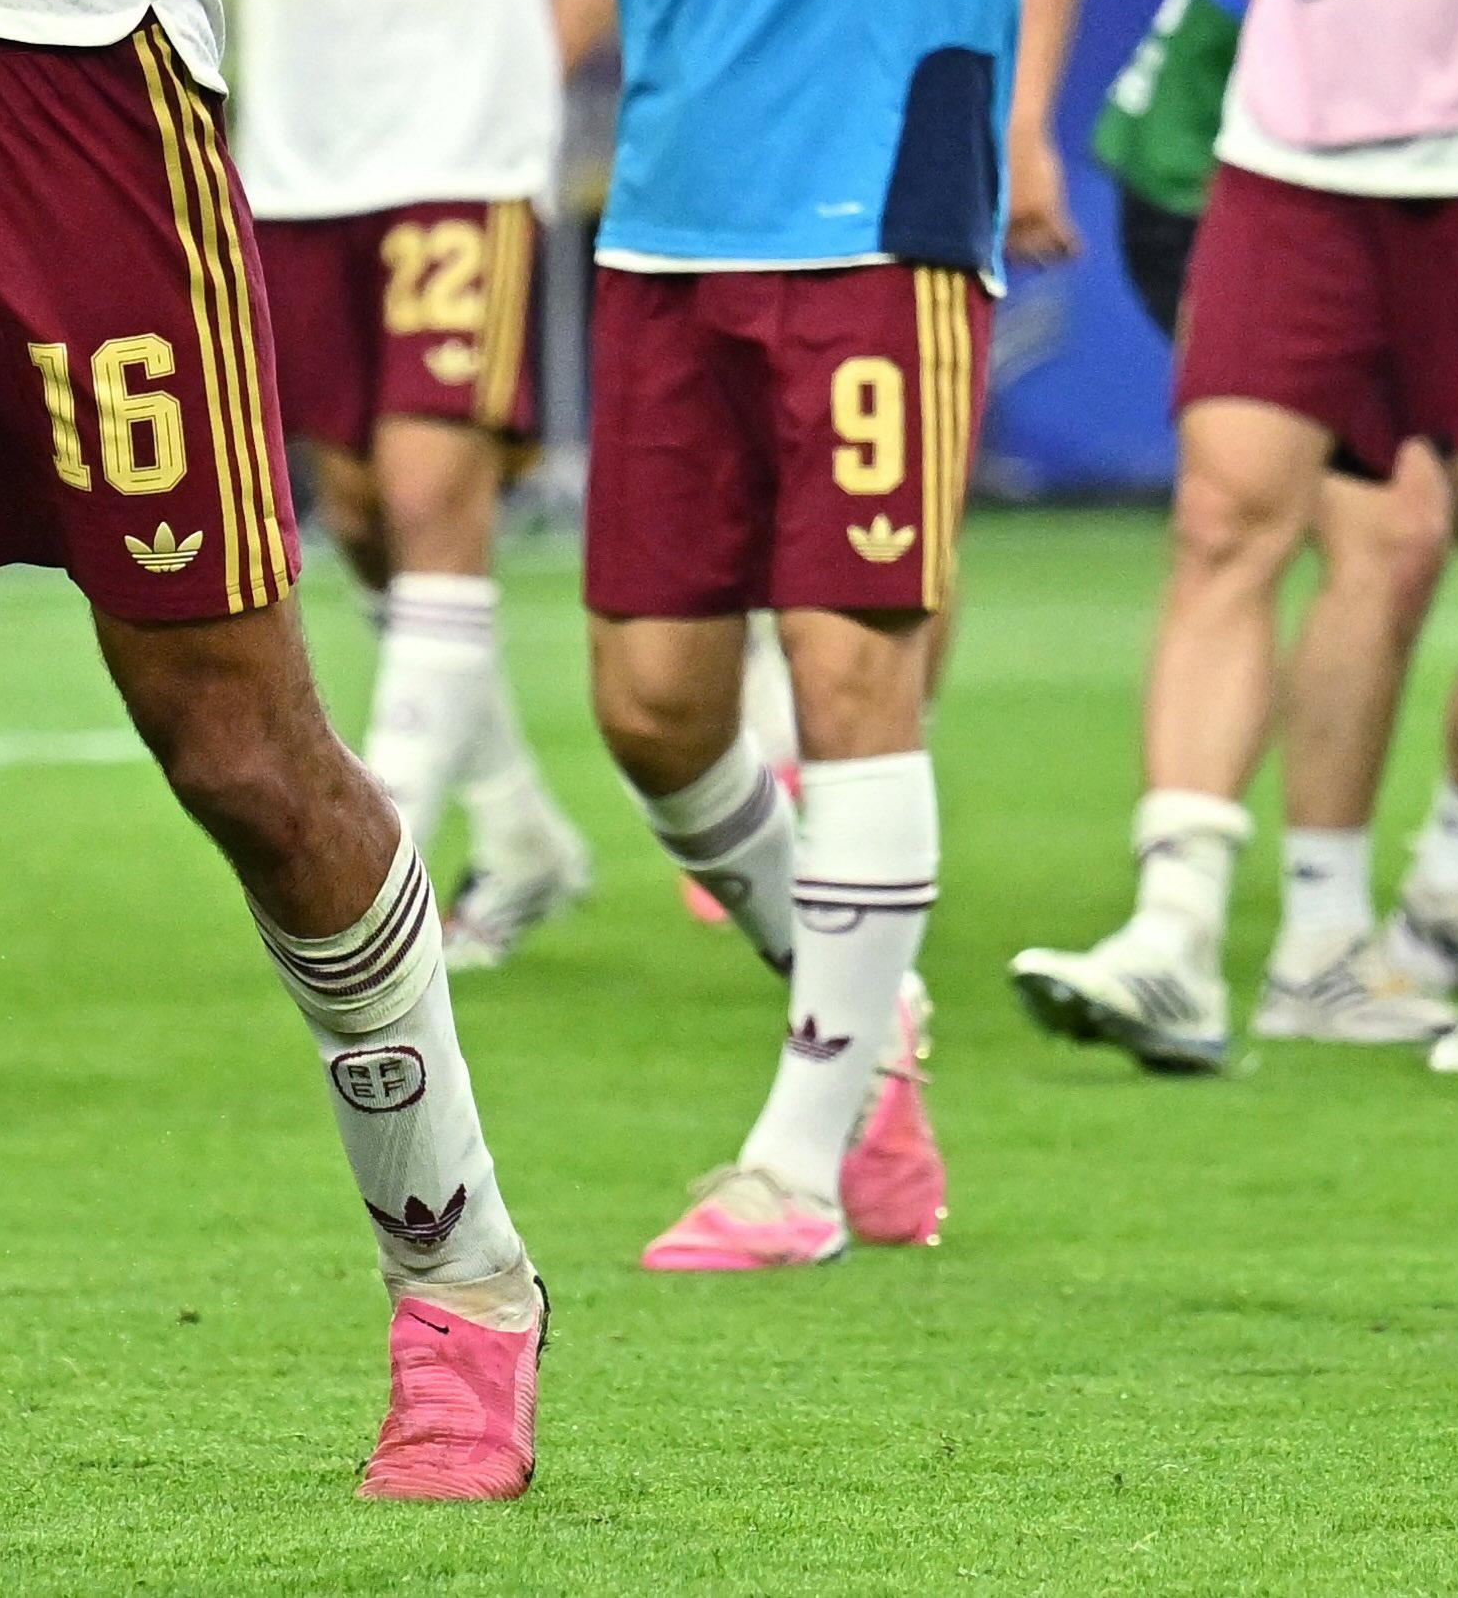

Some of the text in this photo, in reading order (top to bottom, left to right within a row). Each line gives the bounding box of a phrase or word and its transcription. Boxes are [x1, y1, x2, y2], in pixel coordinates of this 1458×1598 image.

[380, 218, 486, 335] 22
[27, 332, 188, 496] 16
[830, 354, 906, 495] 9
